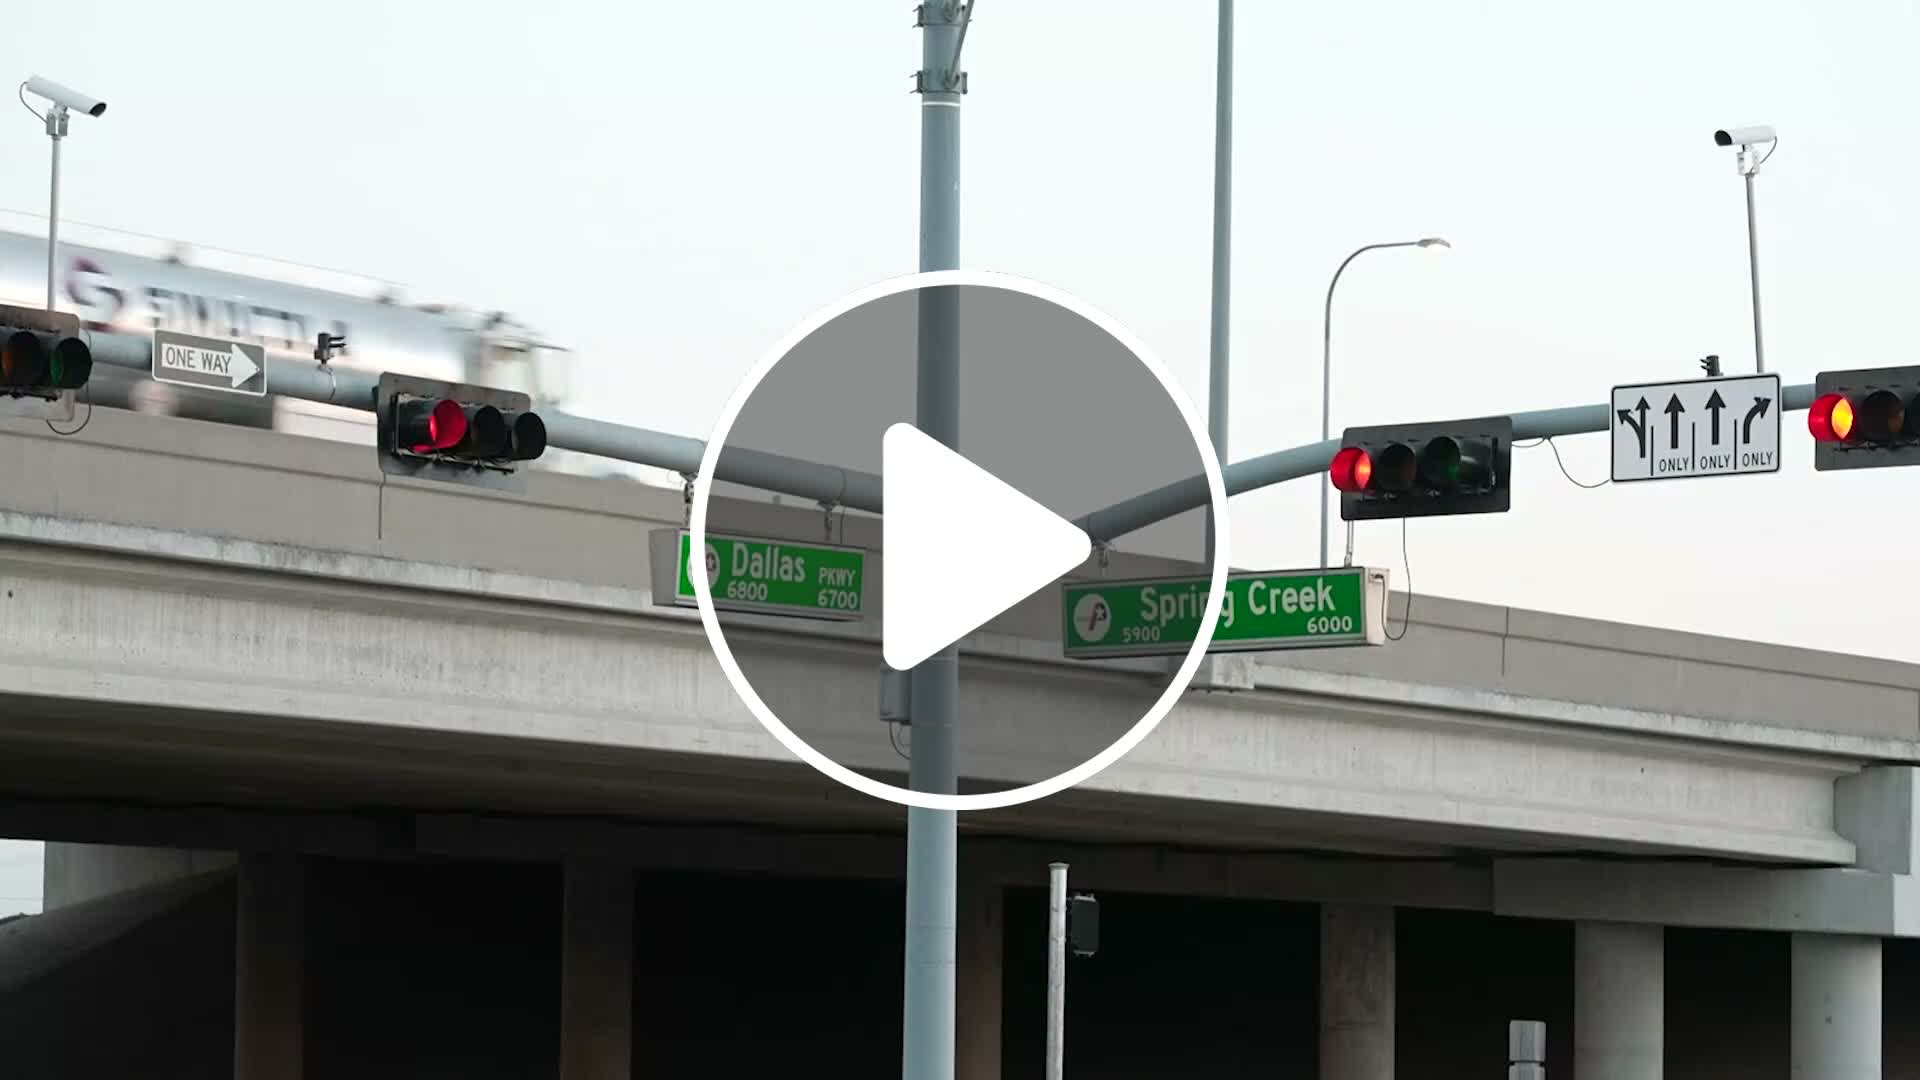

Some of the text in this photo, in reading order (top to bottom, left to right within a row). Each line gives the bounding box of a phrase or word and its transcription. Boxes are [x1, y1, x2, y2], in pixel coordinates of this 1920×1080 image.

[166, 346, 231, 374] ONE WAY
[1658, 451, 1773, 473] ONLY ONLY ONLY
[731, 543, 855, 587] Dallas PKWY
[727, 580, 858, 609] 6800 6700
[1248, 576, 1336, 616] Creek
[1121, 615, 1353, 644] 5900 6000
